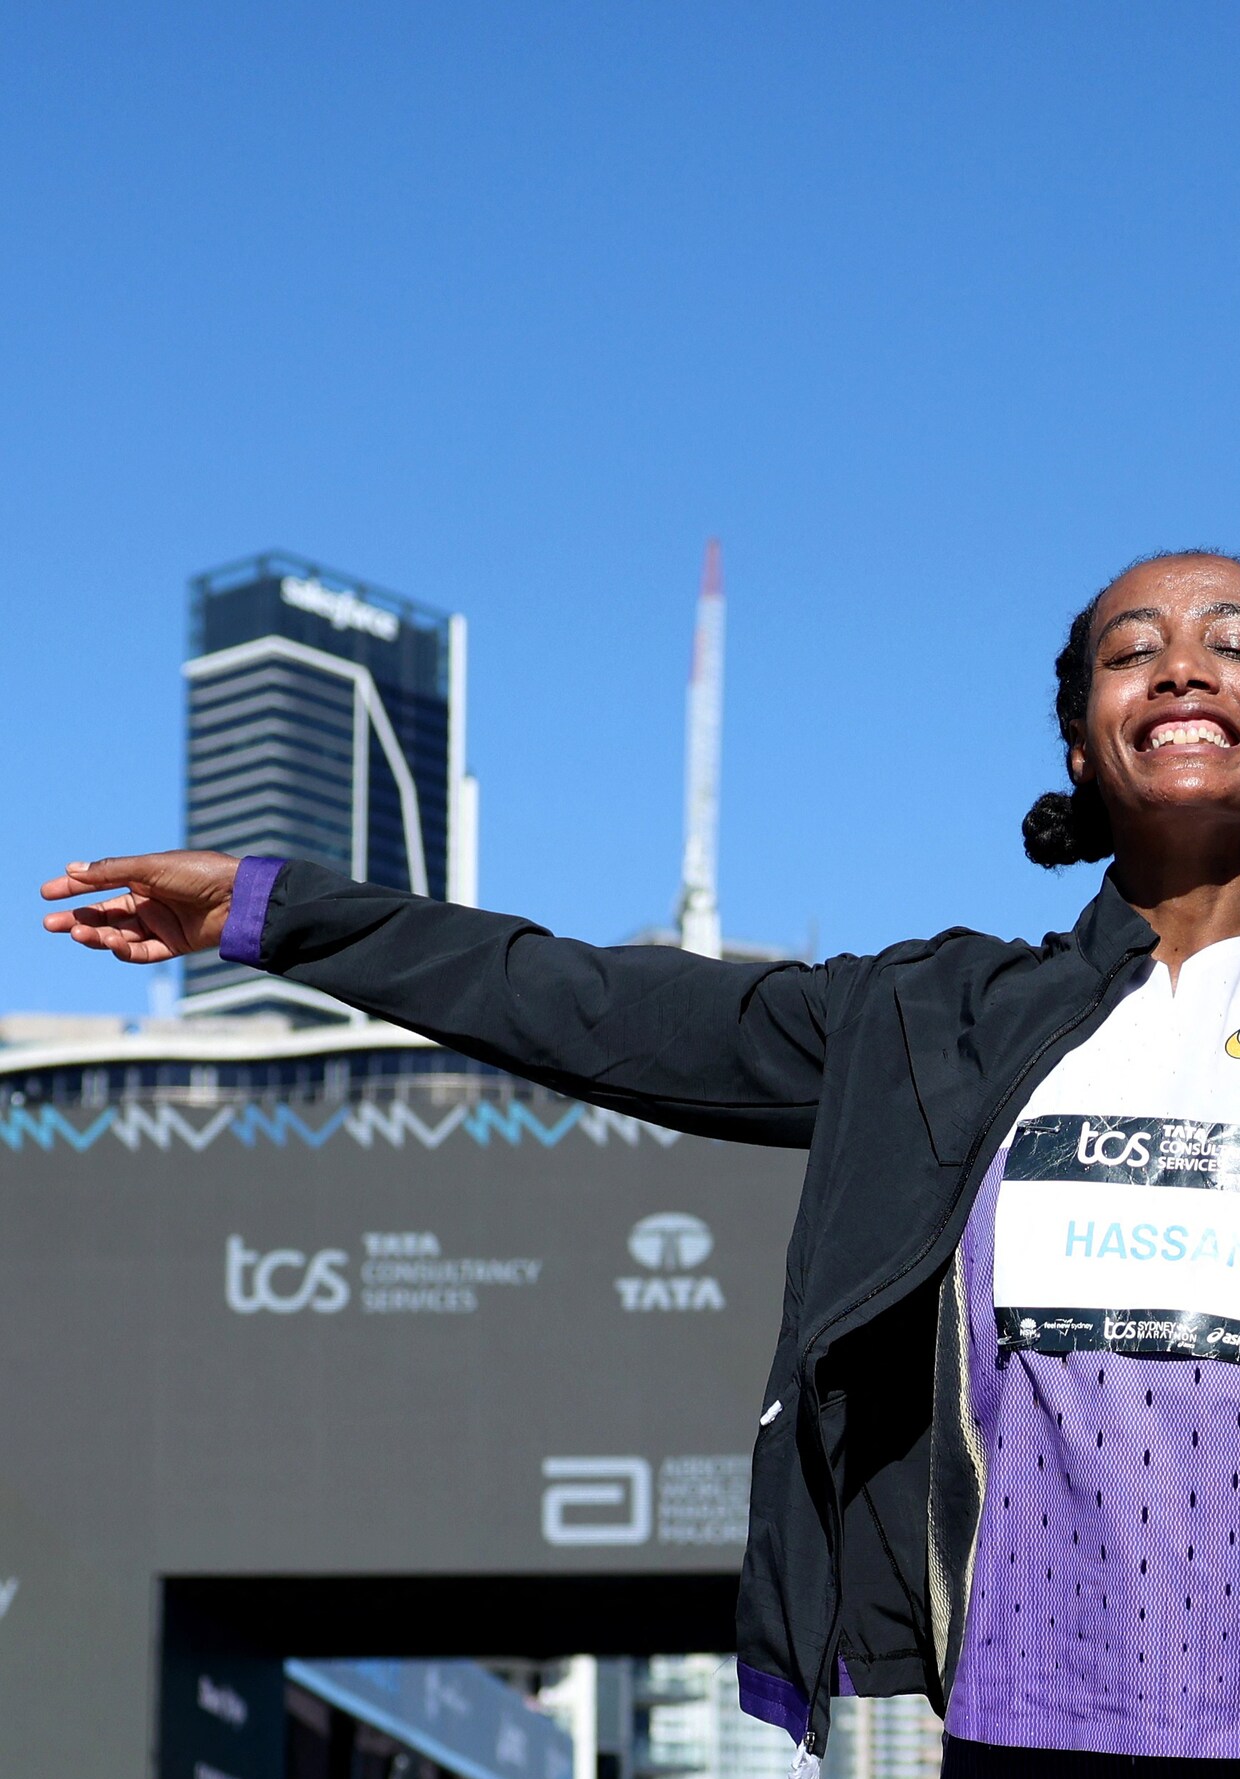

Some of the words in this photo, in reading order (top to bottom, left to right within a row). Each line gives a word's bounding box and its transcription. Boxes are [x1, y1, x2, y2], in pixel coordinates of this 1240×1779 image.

[1077, 1121, 1151, 1168] tcs
[1163, 1125, 1208, 1143] TATA
[362, 1231, 441, 1256] TATA
[226, 1233, 350, 1314] tcs
[362, 1258, 543, 1285] CONSULTANCY
[614, 1276, 725, 1312] TATA
[1104, 1317, 1137, 1340] tcs
[1137, 1321, 1177, 1332] SYDNEY
[1137, 1330, 1198, 1342] MARATHON
